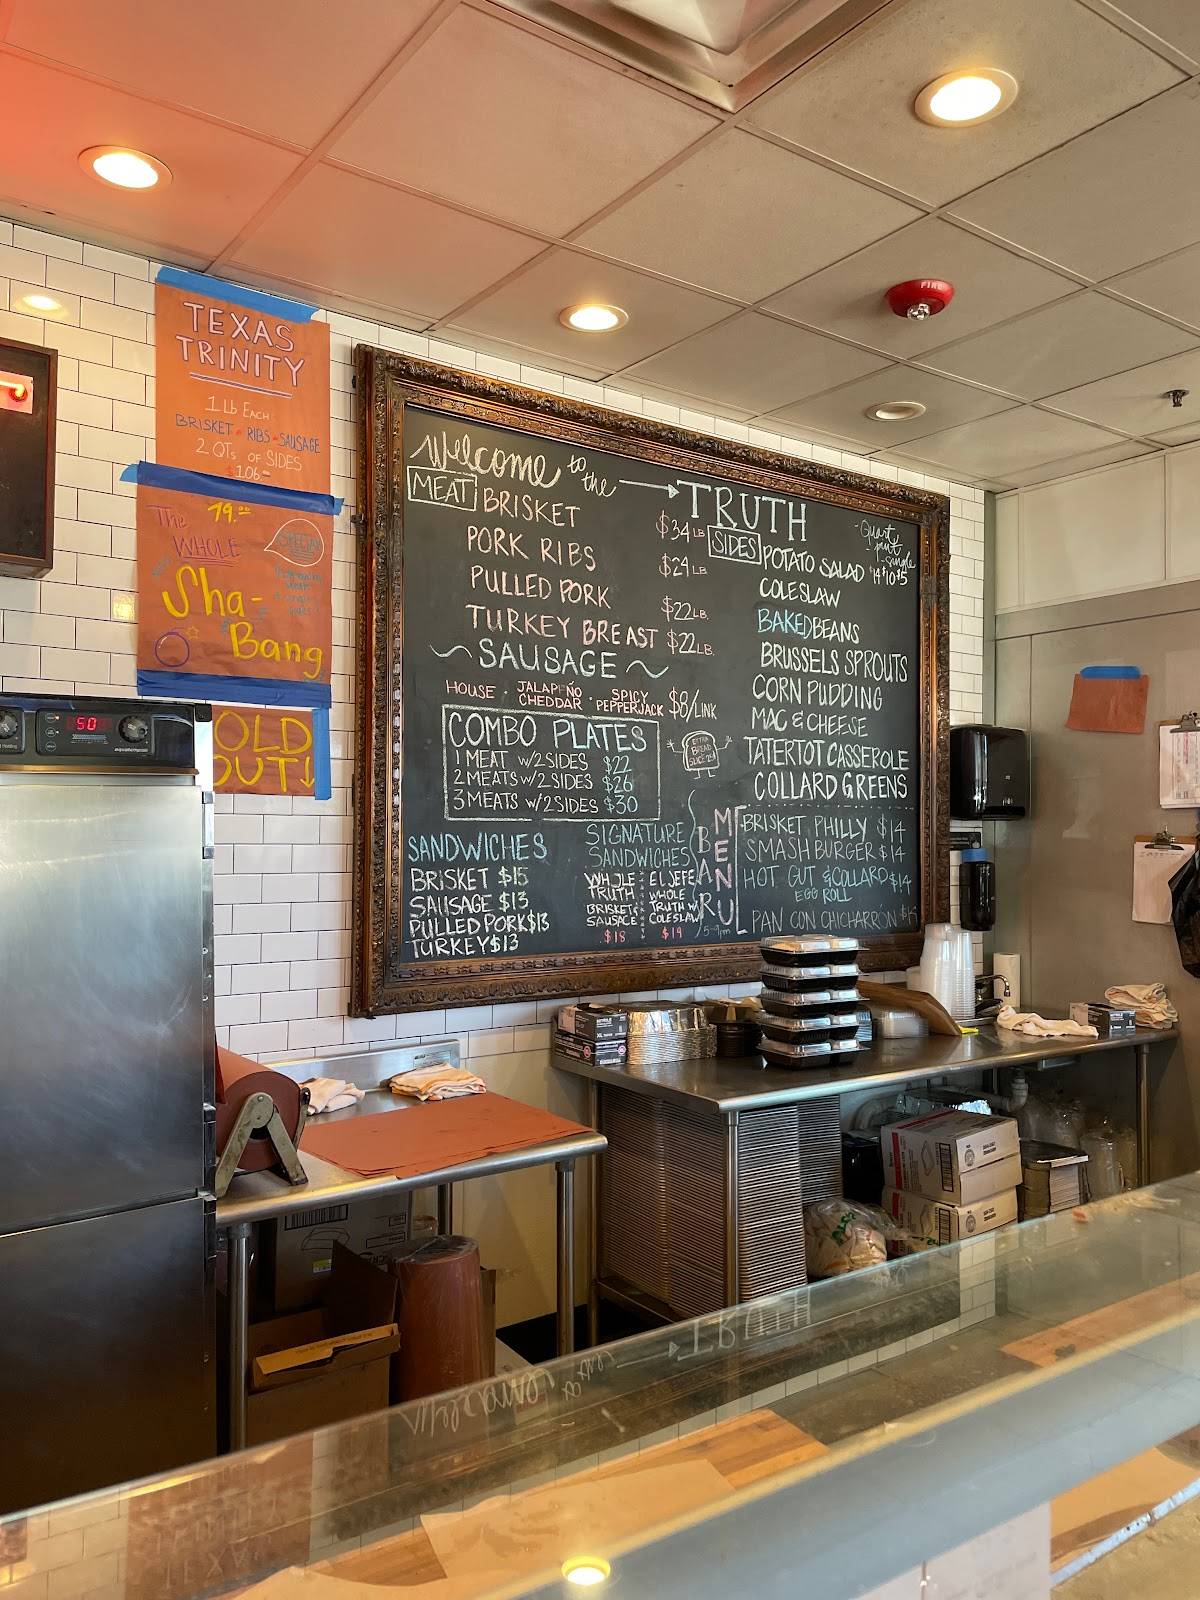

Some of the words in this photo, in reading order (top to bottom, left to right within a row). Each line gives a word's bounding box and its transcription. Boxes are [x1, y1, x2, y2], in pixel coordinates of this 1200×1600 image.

[183, 301, 295, 353] TEXAS
[175, 334, 305, 388] TRINITY
[205, 395, 221, 412] 1
[175, 413, 235, 436] BRISKET
[247, 427, 271, 444] RIBS
[279, 432, 321, 454] SAUSAGE
[196, 438, 209, 455] 2
[266, 449, 303, 471] SIDES
[409, 431, 561, 489] Welcome
[567, 454, 587, 474] to
[581, 471, 617, 498] the
[676, 479, 807, 542] TRUTH
[412, 471, 475, 503] MEAT
[146, 504, 190, 530] The
[483, 487, 581, 528] BRISKET
[172, 535, 241, 559] WHOLE
[467, 524, 530, 561] PORK
[540, 537, 596, 572] RIBS
[711, 530, 757, 560] SIDES
[763, 544, 815, 574] POTATO
[819, 557, 865, 583] SALAD
[470, 565, 552, 600] PULLED
[560, 578, 612, 610] PORK
[759, 577, 842, 608] COLESLAW
[465, 604, 571, 639] TURKEY
[583, 619, 659, 650] BREAST
[229, 621, 323, 680] Bang
[478, 637, 618, 679] SAUSAGE
[760, 641, 840, 676] BRUSSELS
[845, 649, 908, 683] SPROUTS
[446, 680, 497, 699] HOUSE
[611, 688, 650, 704] SPICY
[518, 693, 583, 711] CHEDDAR
[596, 699, 664, 717] PEPPERJACK
[752, 674, 802, 705] CORN
[807, 679, 883, 711] PUDDING
[76, 716, 97, 731] 50
[214, 710, 313, 754] OLD
[448, 711, 537, 748] COMBO
[552, 718, 647, 753] PLATES
[751, 706, 788, 732] MAC
[806, 712, 869, 738] CHEESE
[466, 749, 509, 769] MEAT
[603, 755, 633, 775] $22
[827, 742, 910, 771] CASSEROLE
[453, 769, 465, 785] 2
[466, 770, 518, 787] MEATS
[553, 773, 594, 790] SIDES
[602, 775, 634, 794] $26
[754, 771, 838, 801] COLLARD
[841, 772, 908, 800] GREENS
[453, 788, 465, 811] 3
[467, 791, 519, 811] MEATS
[603, 795, 639, 815] $30
[584, 821, 686, 846] SIGNATURE
[742, 813, 807, 835] BRISKET
[814, 815, 867, 843] PHILLY
[876, 813, 907, 844] $14
[408, 832, 548, 862] SANDWICHES
[588, 846, 691, 868] SANDWICHES
[745, 837, 811, 863] SMASH
[814, 840, 877, 862] BURGER
[879, 844, 907, 863] $14
[410, 867, 489, 892] BRISKET
[498, 865, 529, 887] $15
[583, 871, 636, 888] WHOLE
[743, 865, 780, 889] HOT
[788, 864, 817, 888] GUT
[409, 893, 494, 919] SAUSAGE
[499, 891, 529, 913] $13
[588, 885, 636, 901] TRUTH
[649, 888, 687, 901] WHOLE
[649, 901, 685, 913] TRUTH
[794, 887, 818, 902] EGG
[822, 887, 853, 904] ROLL
[586, 903, 632, 916] BRISKET
[649, 912, 700, 924] COLESLAW
[752, 906, 784, 934] PAN
[789, 910, 817, 930] CON
[409, 917, 481, 940] PULLED
[484, 913, 528, 933] PORK
[604, 929, 626, 944] $18
[408, 935, 490, 959] TURKEY
[489, 933, 519, 953] $13
